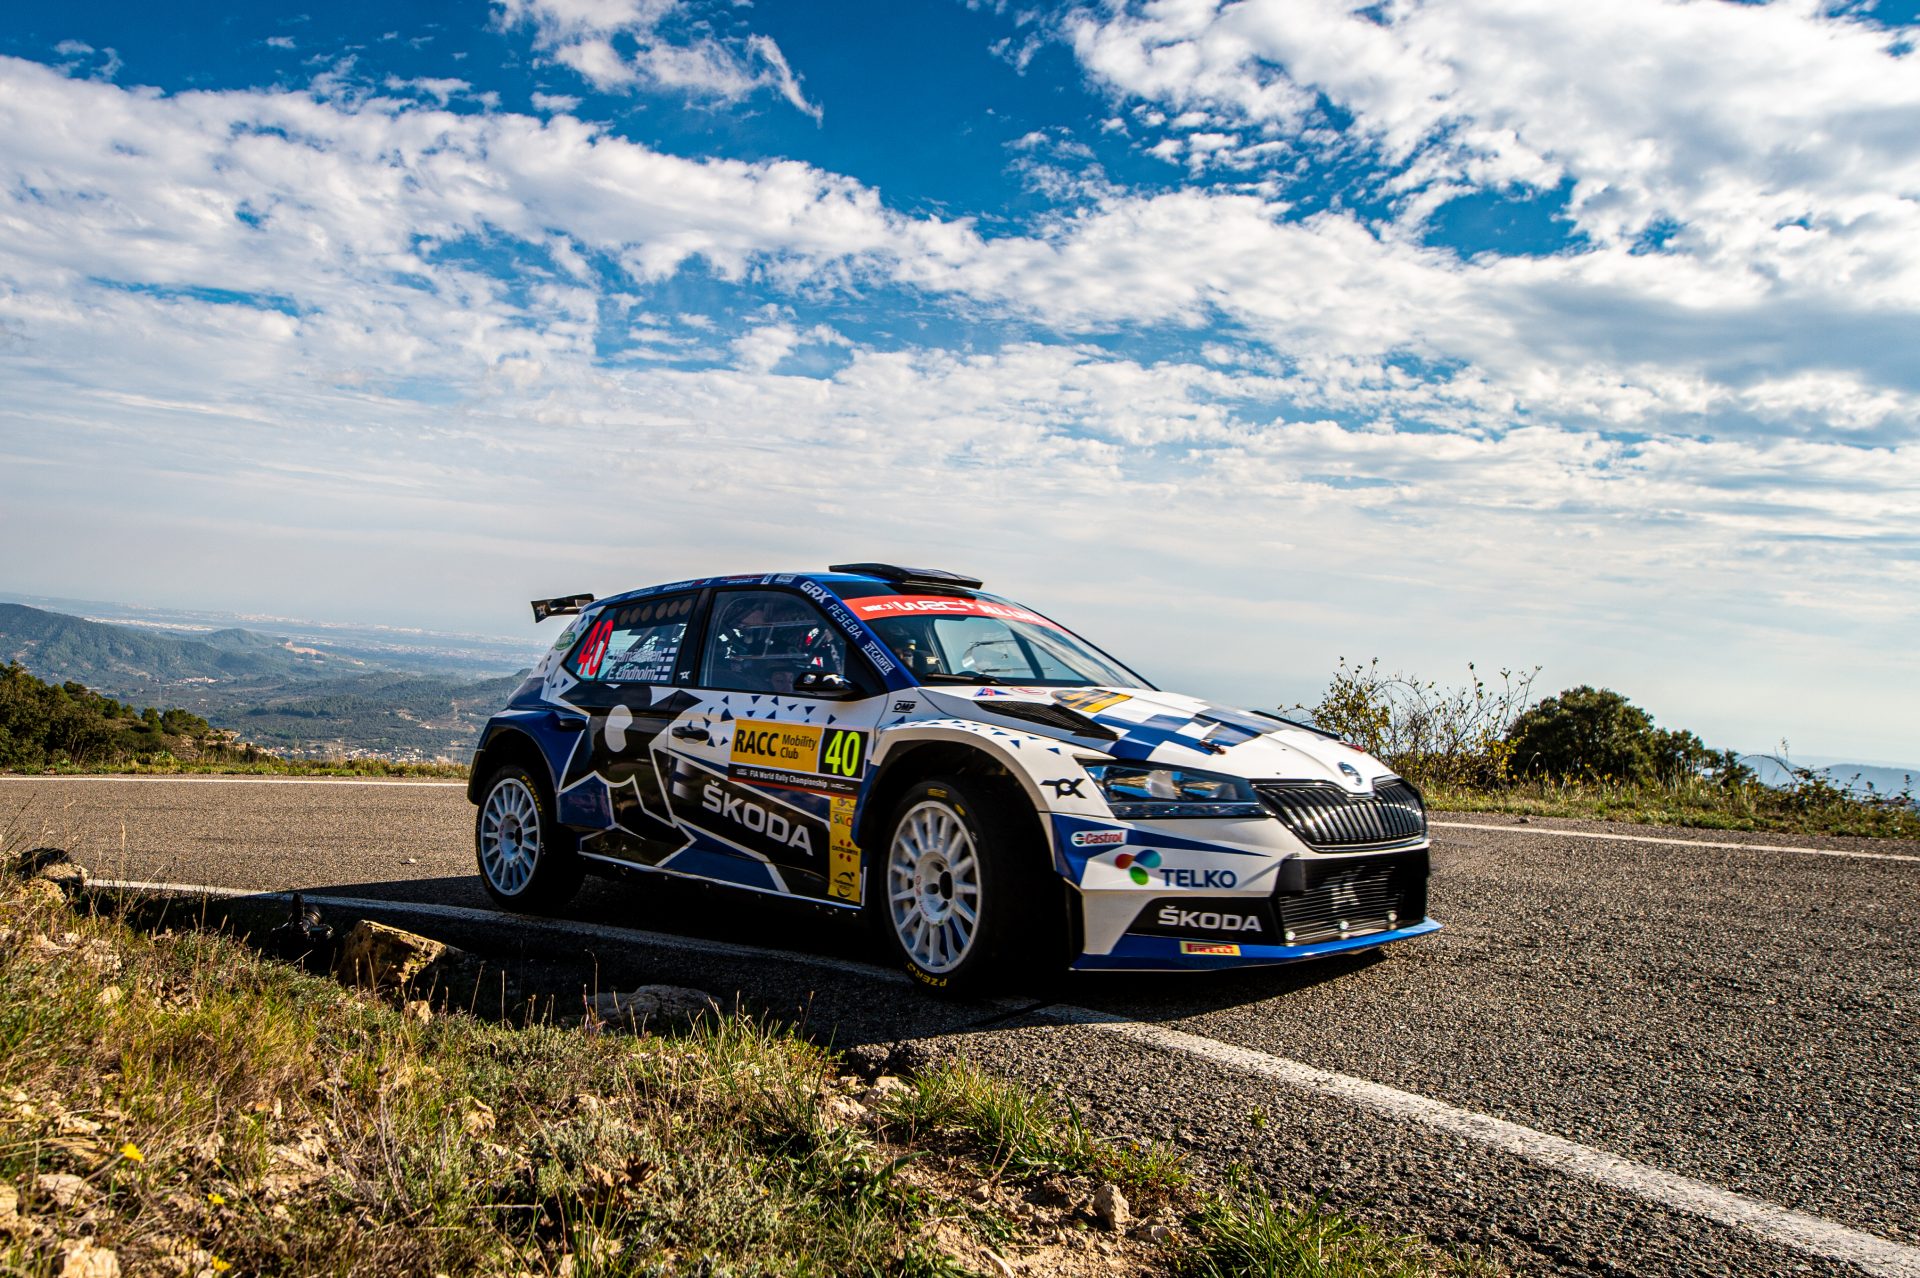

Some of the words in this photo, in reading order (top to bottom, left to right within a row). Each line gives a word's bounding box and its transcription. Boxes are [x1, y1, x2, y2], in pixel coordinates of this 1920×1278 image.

[800, 580, 832, 603] GRX
[828, 603, 863, 640] PESEBA
[577, 619, 614, 676] 40
[615, 665, 656, 681] Lindholm
[894, 702, 916, 711] OMP
[734, 729, 779, 757] RACC
[782, 734, 818, 751] Mobility
[780, 747, 799, 760] Club
[824, 730, 861, 777] 40
[750, 769, 759, 778] FIA
[759, 771, 774, 780] World
[775, 773, 788, 783] Rally
[789, 775, 828, 789] Championship
[702, 779, 814, 857] ŠKODA
[1085, 832, 1124, 845] Castrol
[1159, 868, 1238, 889] TELKO
[1157, 905, 1263, 932] ŠKODA
